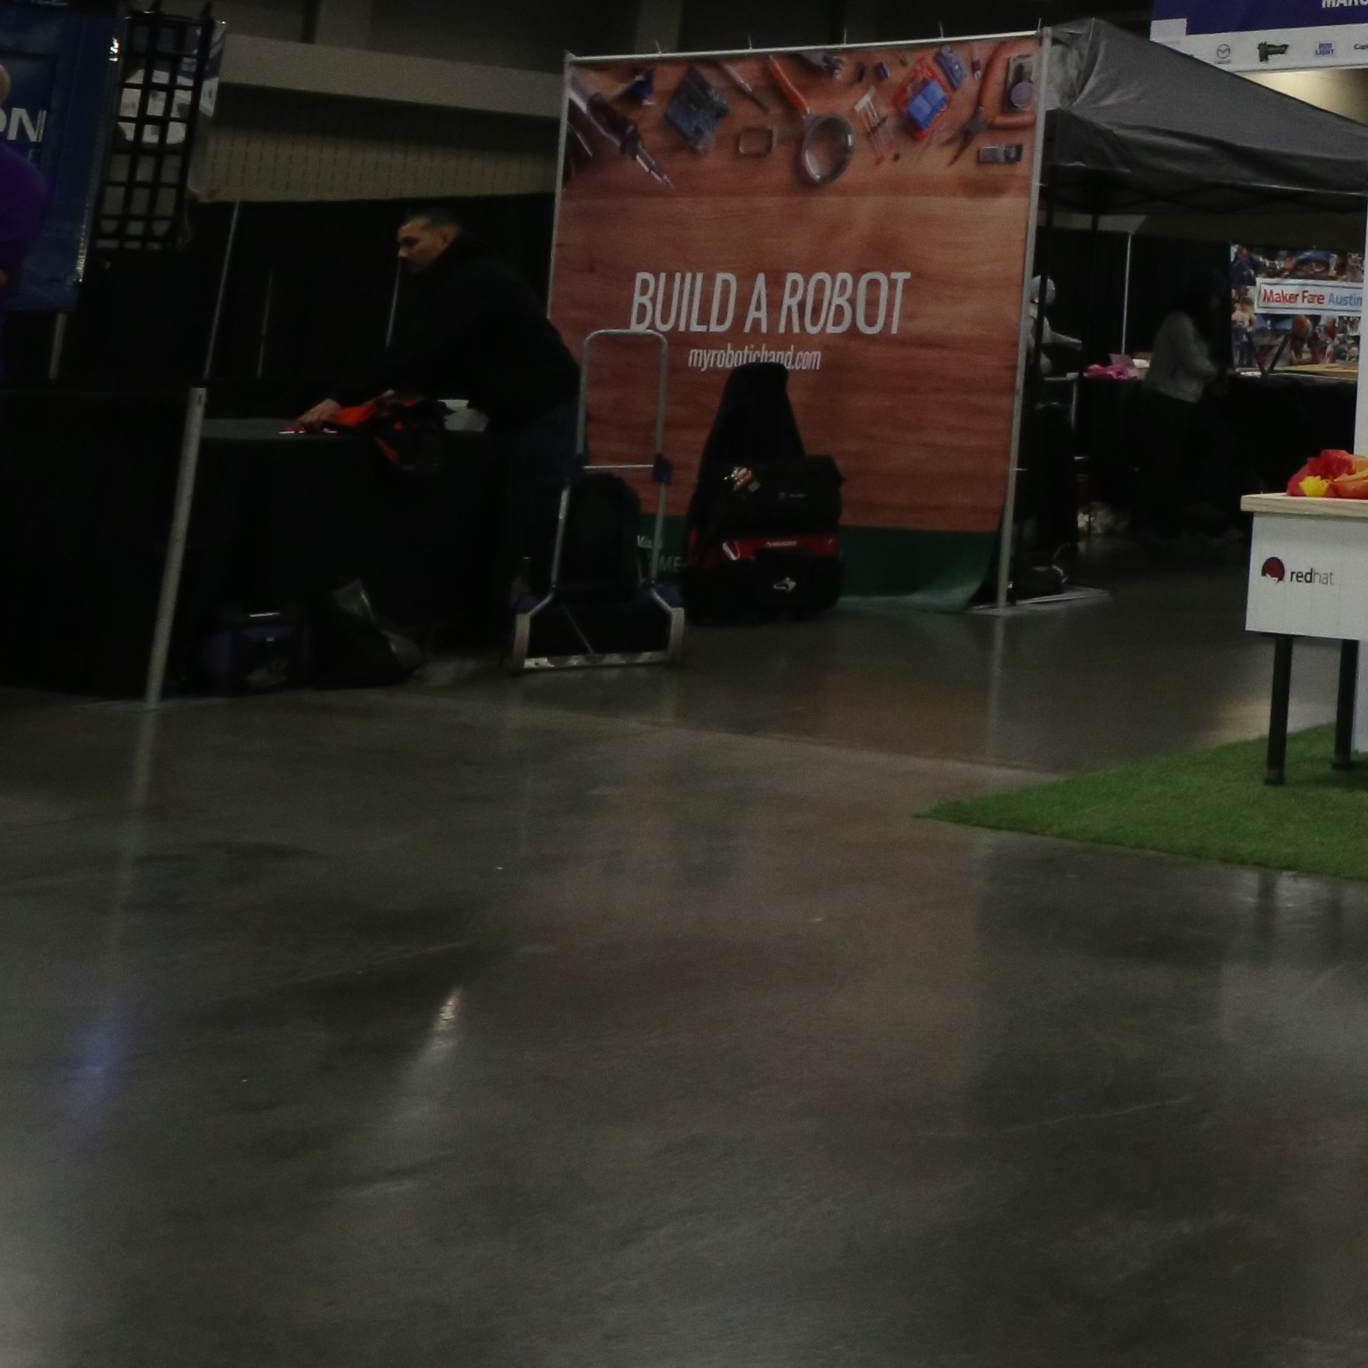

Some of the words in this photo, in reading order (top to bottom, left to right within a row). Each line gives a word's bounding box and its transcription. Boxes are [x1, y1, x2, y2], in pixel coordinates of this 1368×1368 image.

[630, 271, 737, 333] BUILD
[743, 271, 768, 334] A
[778, 270, 911, 335] ROBOT
[1263, 289, 1299, 304] Maker
[688, 343, 821, 372] myrobotichand.com
[1290, 567, 1334, 586] redhat
